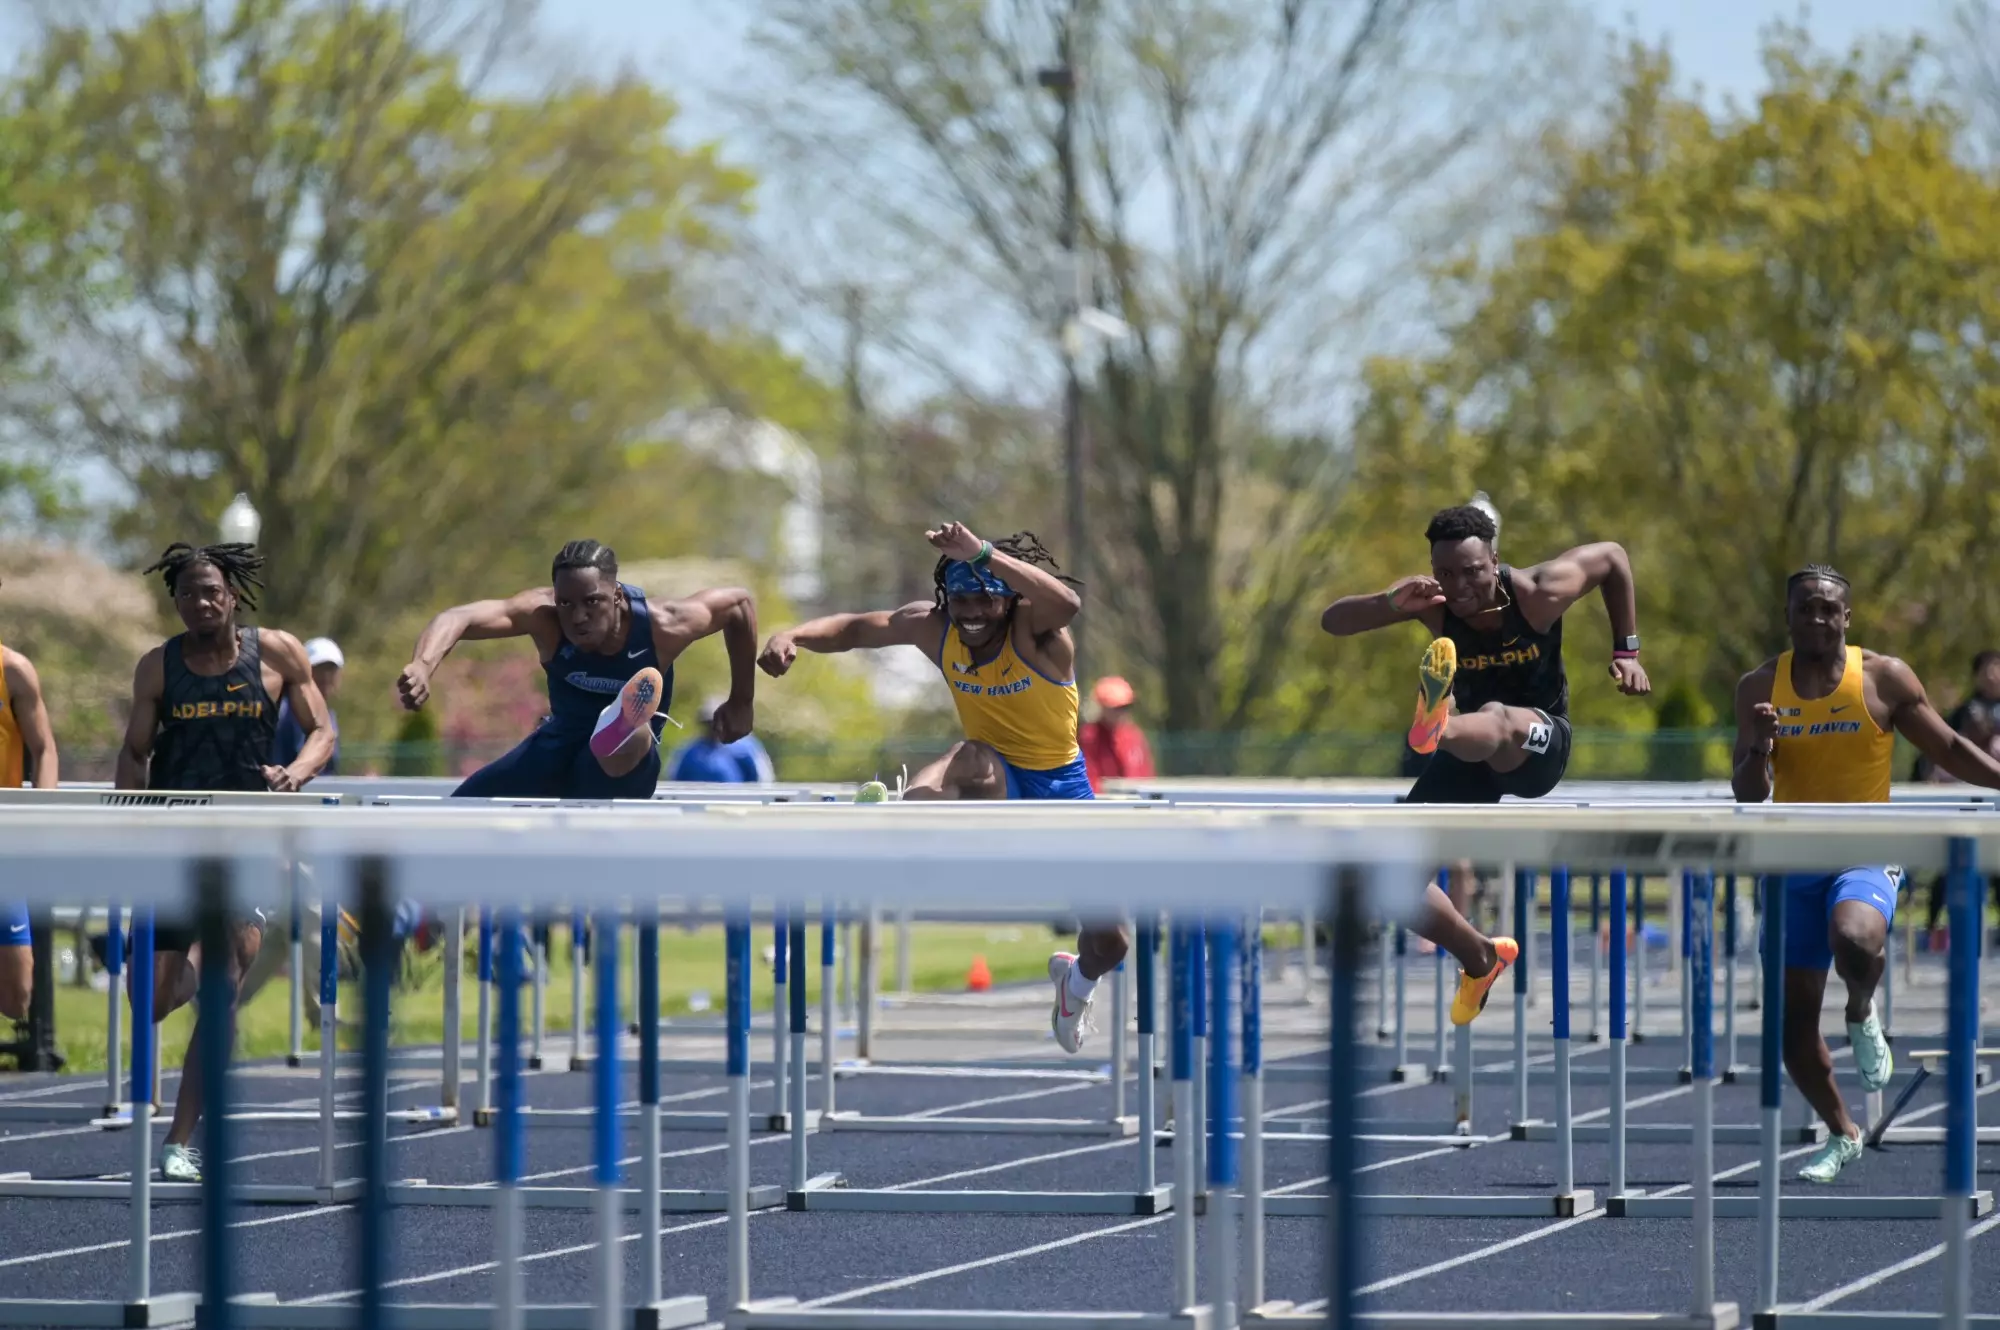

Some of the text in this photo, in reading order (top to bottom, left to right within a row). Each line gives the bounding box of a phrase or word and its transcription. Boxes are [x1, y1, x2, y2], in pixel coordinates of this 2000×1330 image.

[1457, 643, 1540, 670] DELPHI
[953, 675, 1032, 696] NEW HAVEN
[1528, 726, 1549, 747] 3
[1808, 721, 1861, 735] HAVEN
